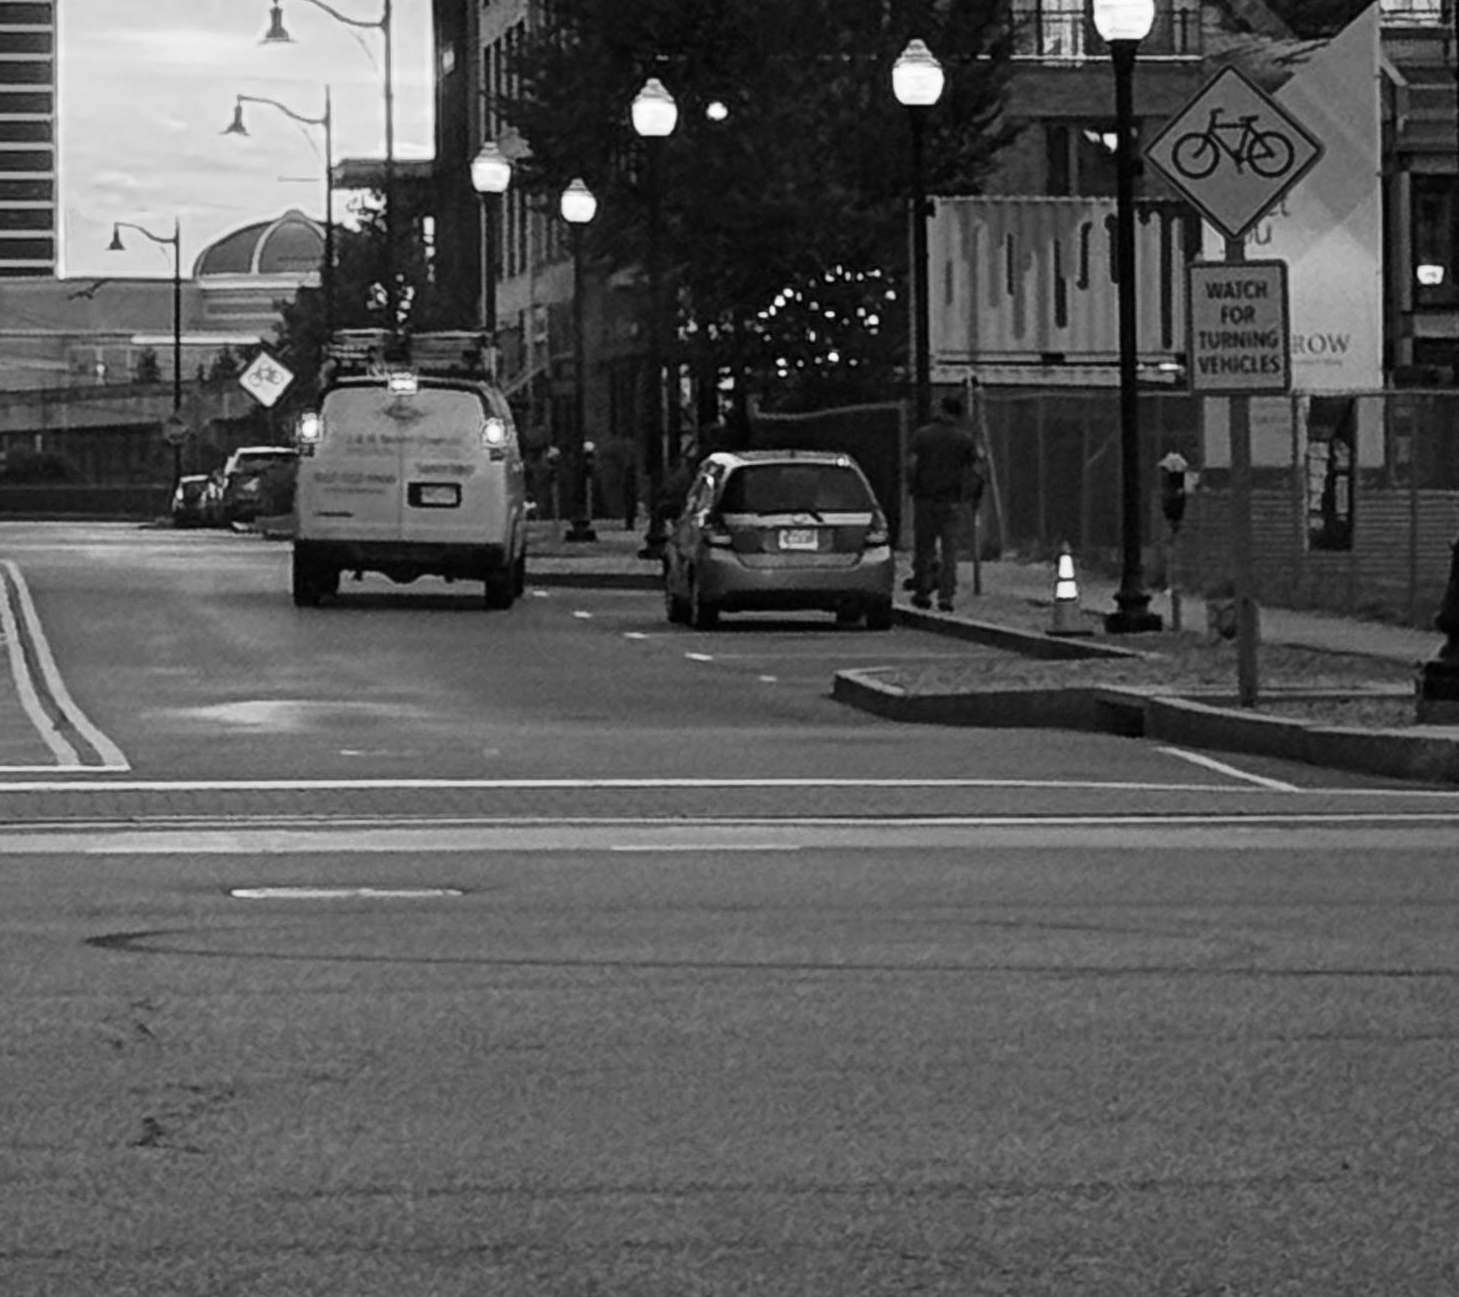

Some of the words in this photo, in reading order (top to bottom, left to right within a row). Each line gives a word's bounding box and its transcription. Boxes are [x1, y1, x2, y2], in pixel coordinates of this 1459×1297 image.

[1204, 280, 1268, 300] WATCH
[1220, 305, 1256, 324] FOR
[1198, 330, 1279, 350] TURNING
[1292, 333, 1351, 354] ROW
[1198, 354, 1281, 375] VEHICLES
